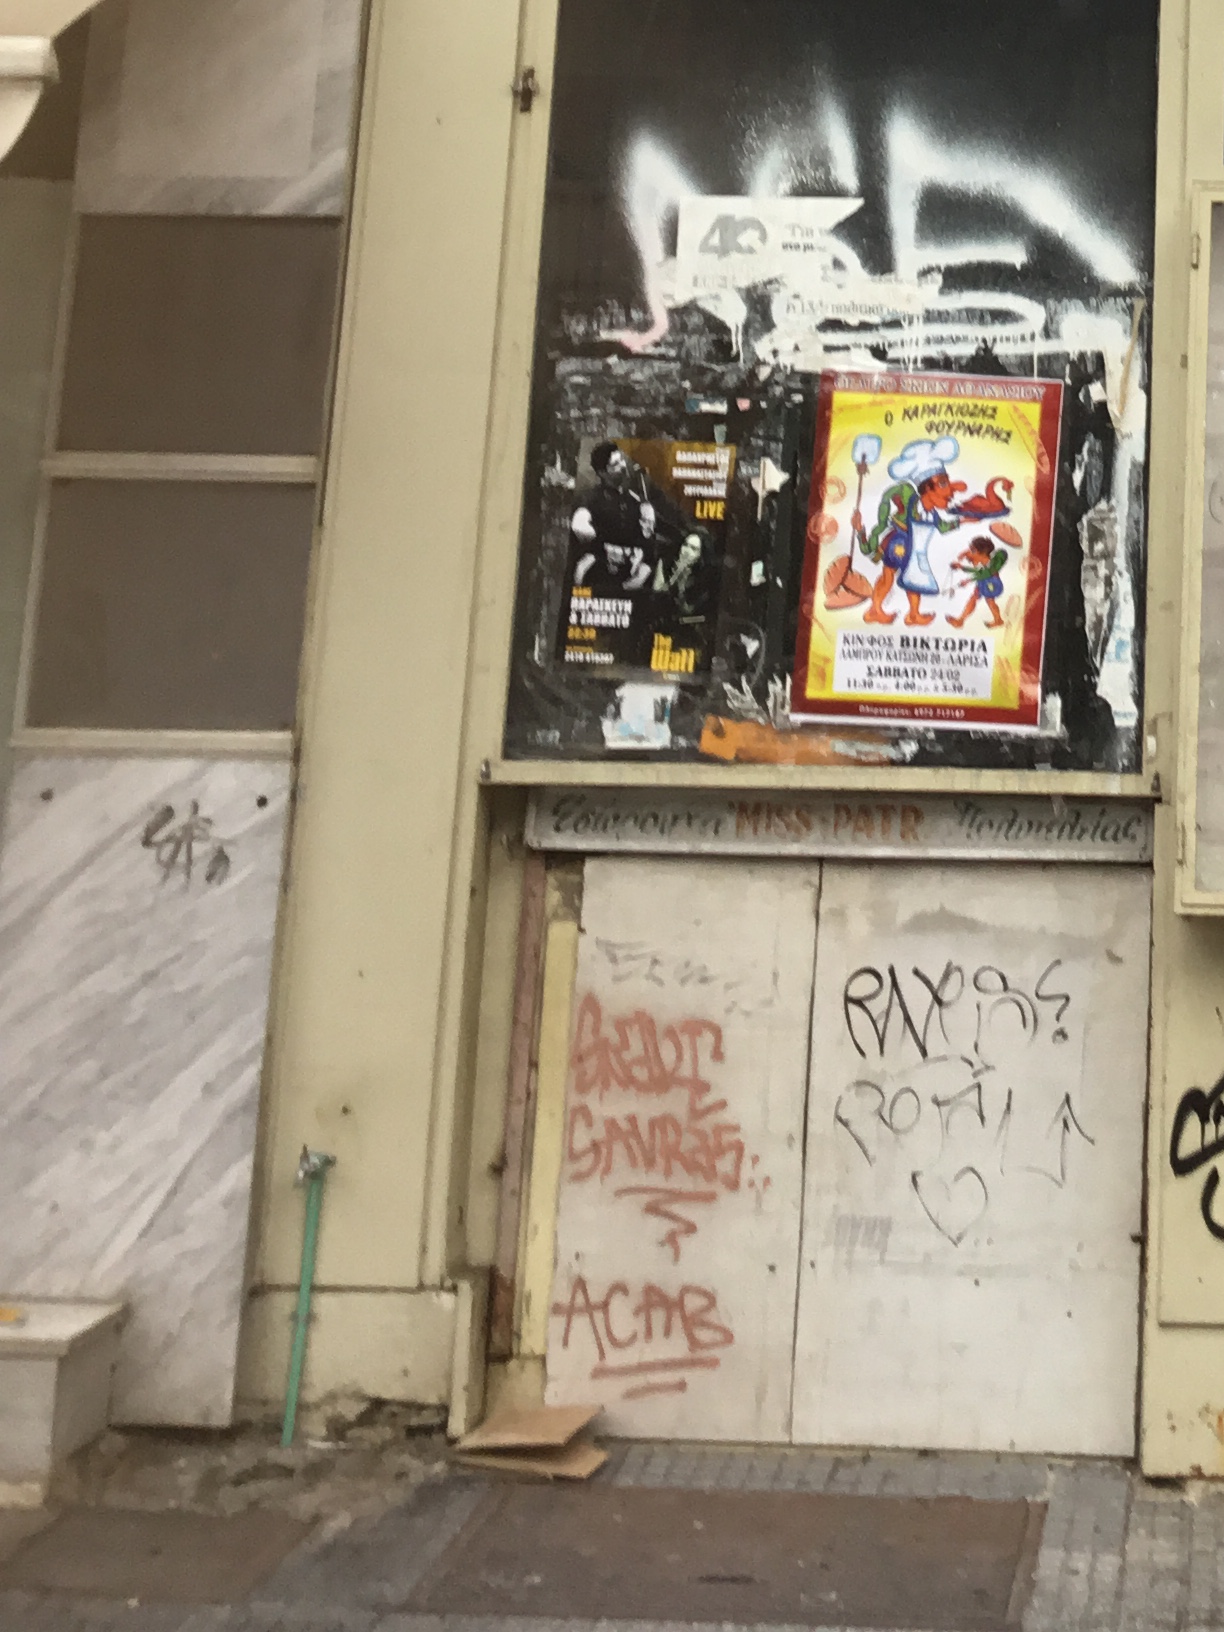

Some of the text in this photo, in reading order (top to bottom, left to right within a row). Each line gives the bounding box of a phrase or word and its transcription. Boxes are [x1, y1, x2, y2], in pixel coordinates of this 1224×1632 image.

[902, 402, 998, 422] ΚΑΡΑΓΚΙΟΖΗΣ
[925, 419, 1012, 445] ΦΟΥΡΝΑΡΗΣ
[695, 500, 726, 521] LIVE
[899, 634, 988, 654] ΒΙΚΤΩΡΙΑ
[651, 647, 695, 673] Wall
[866, 665, 927, 680] ΣΑΒΒΑΤΟ
[552, 1274, 734, 1359] ACAB
